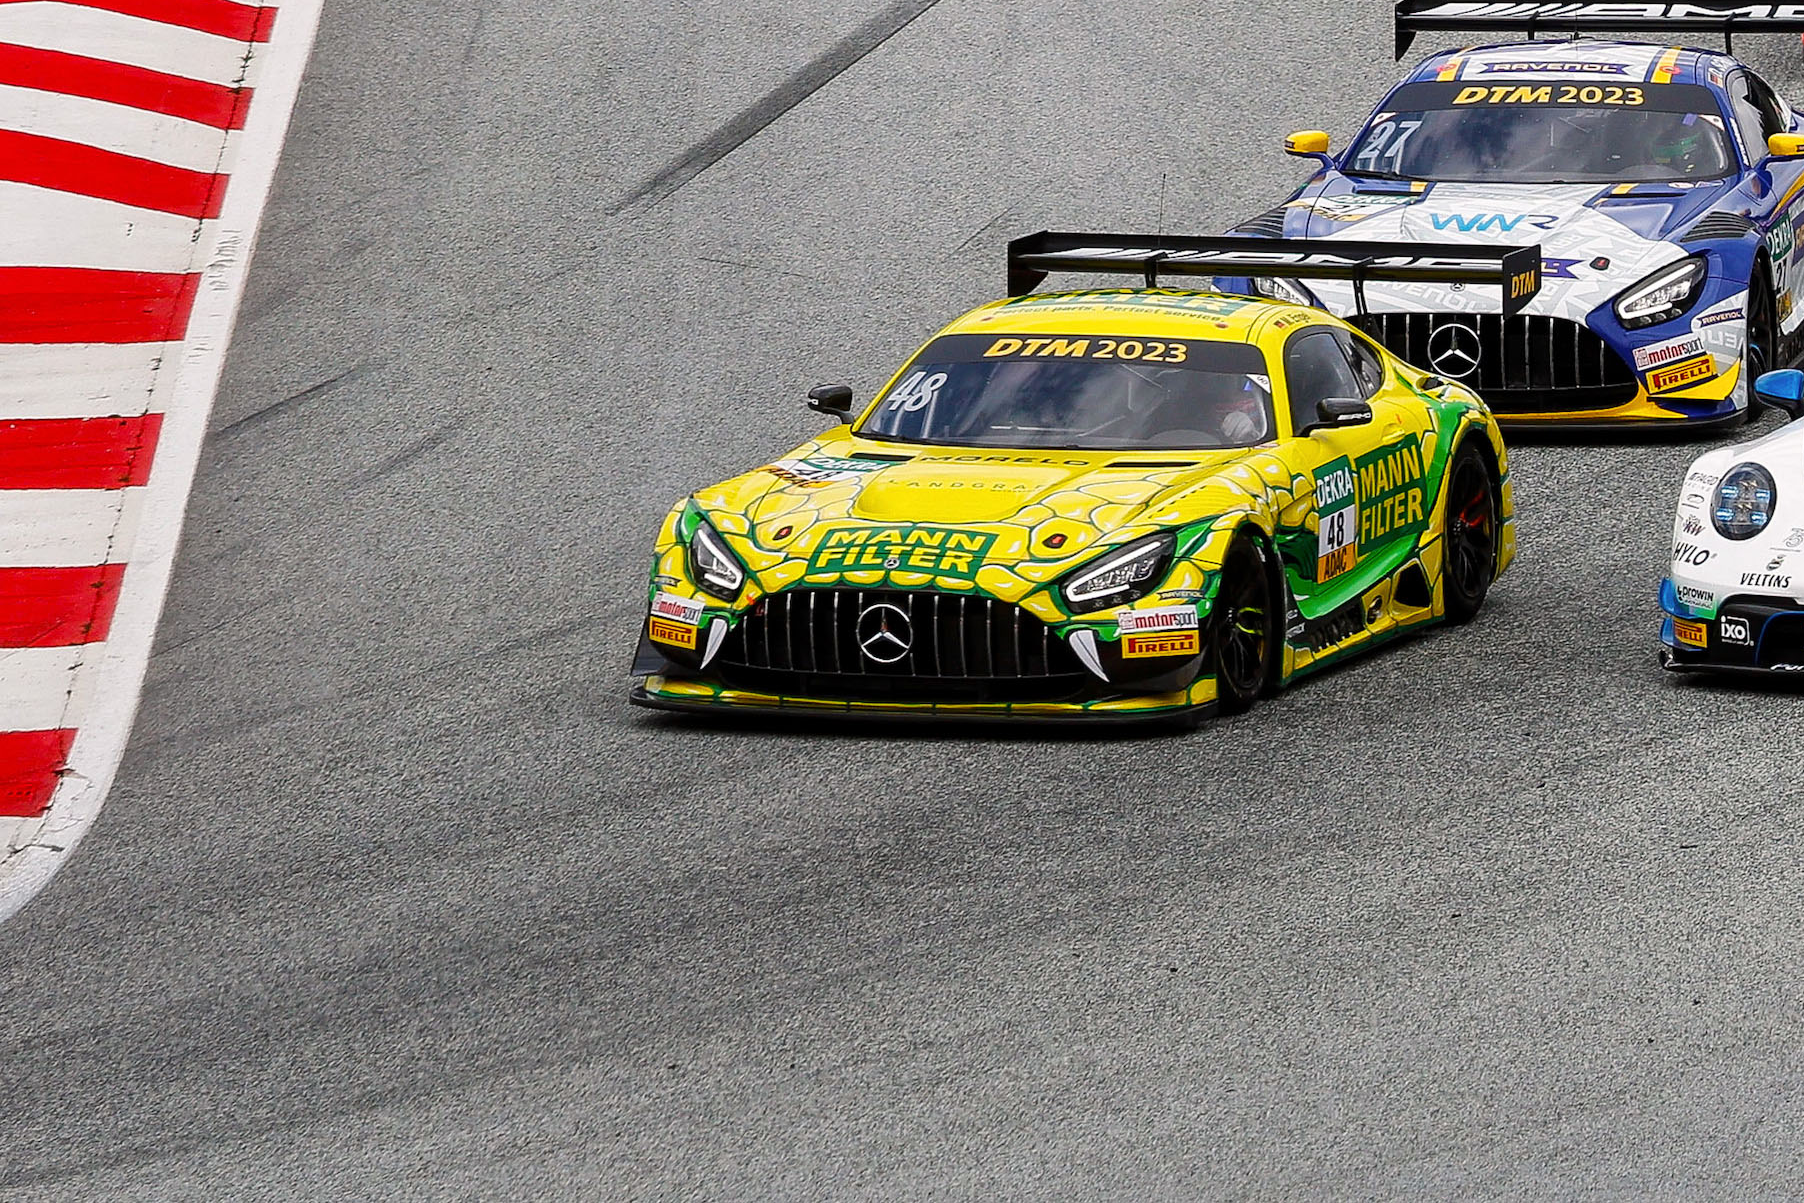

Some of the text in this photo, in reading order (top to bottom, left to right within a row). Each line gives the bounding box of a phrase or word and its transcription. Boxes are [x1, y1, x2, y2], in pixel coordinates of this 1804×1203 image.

[1492, 62, 1618, 73] RAVENOL
[1451, 85, 1645, 107] DTM 2023
[1356, 120, 1422, 159] 27
[1510, 270, 1536, 298] DTM
[1102, 305, 1160, 316] Perfect
[1162, 309, 1226, 323] service.
[1702, 311, 1742, 325] RAVENOL
[983, 337, 1188, 364] DTM 2023
[1649, 337, 1704, 364] motorsport
[1652, 358, 1712, 390] PIRELLI
[887, 371, 948, 412] 48
[917, 455, 1090, 467] MORELO
[1361, 445, 1421, 498] MANN
[887, 478, 1049, 491] LANDGRAF
[1317, 465, 1354, 508] DEKRA
[1360, 486, 1424, 545] FILTER
[824, 525, 990, 552] MANN
[1326, 511, 1346, 550] 48
[813, 544, 976, 576] FILTER
[1323, 546, 1348, 580] ADAC
[1740, 572, 1792, 589] VELTINS
[658, 599, 702, 622] motorsport
[1134, 610, 1198, 631] motorsport
[651, 619, 693, 645] PIRELLI
[1720, 615, 1746, 640] ixo
[1128, 633, 1194, 654] PIRELLI
